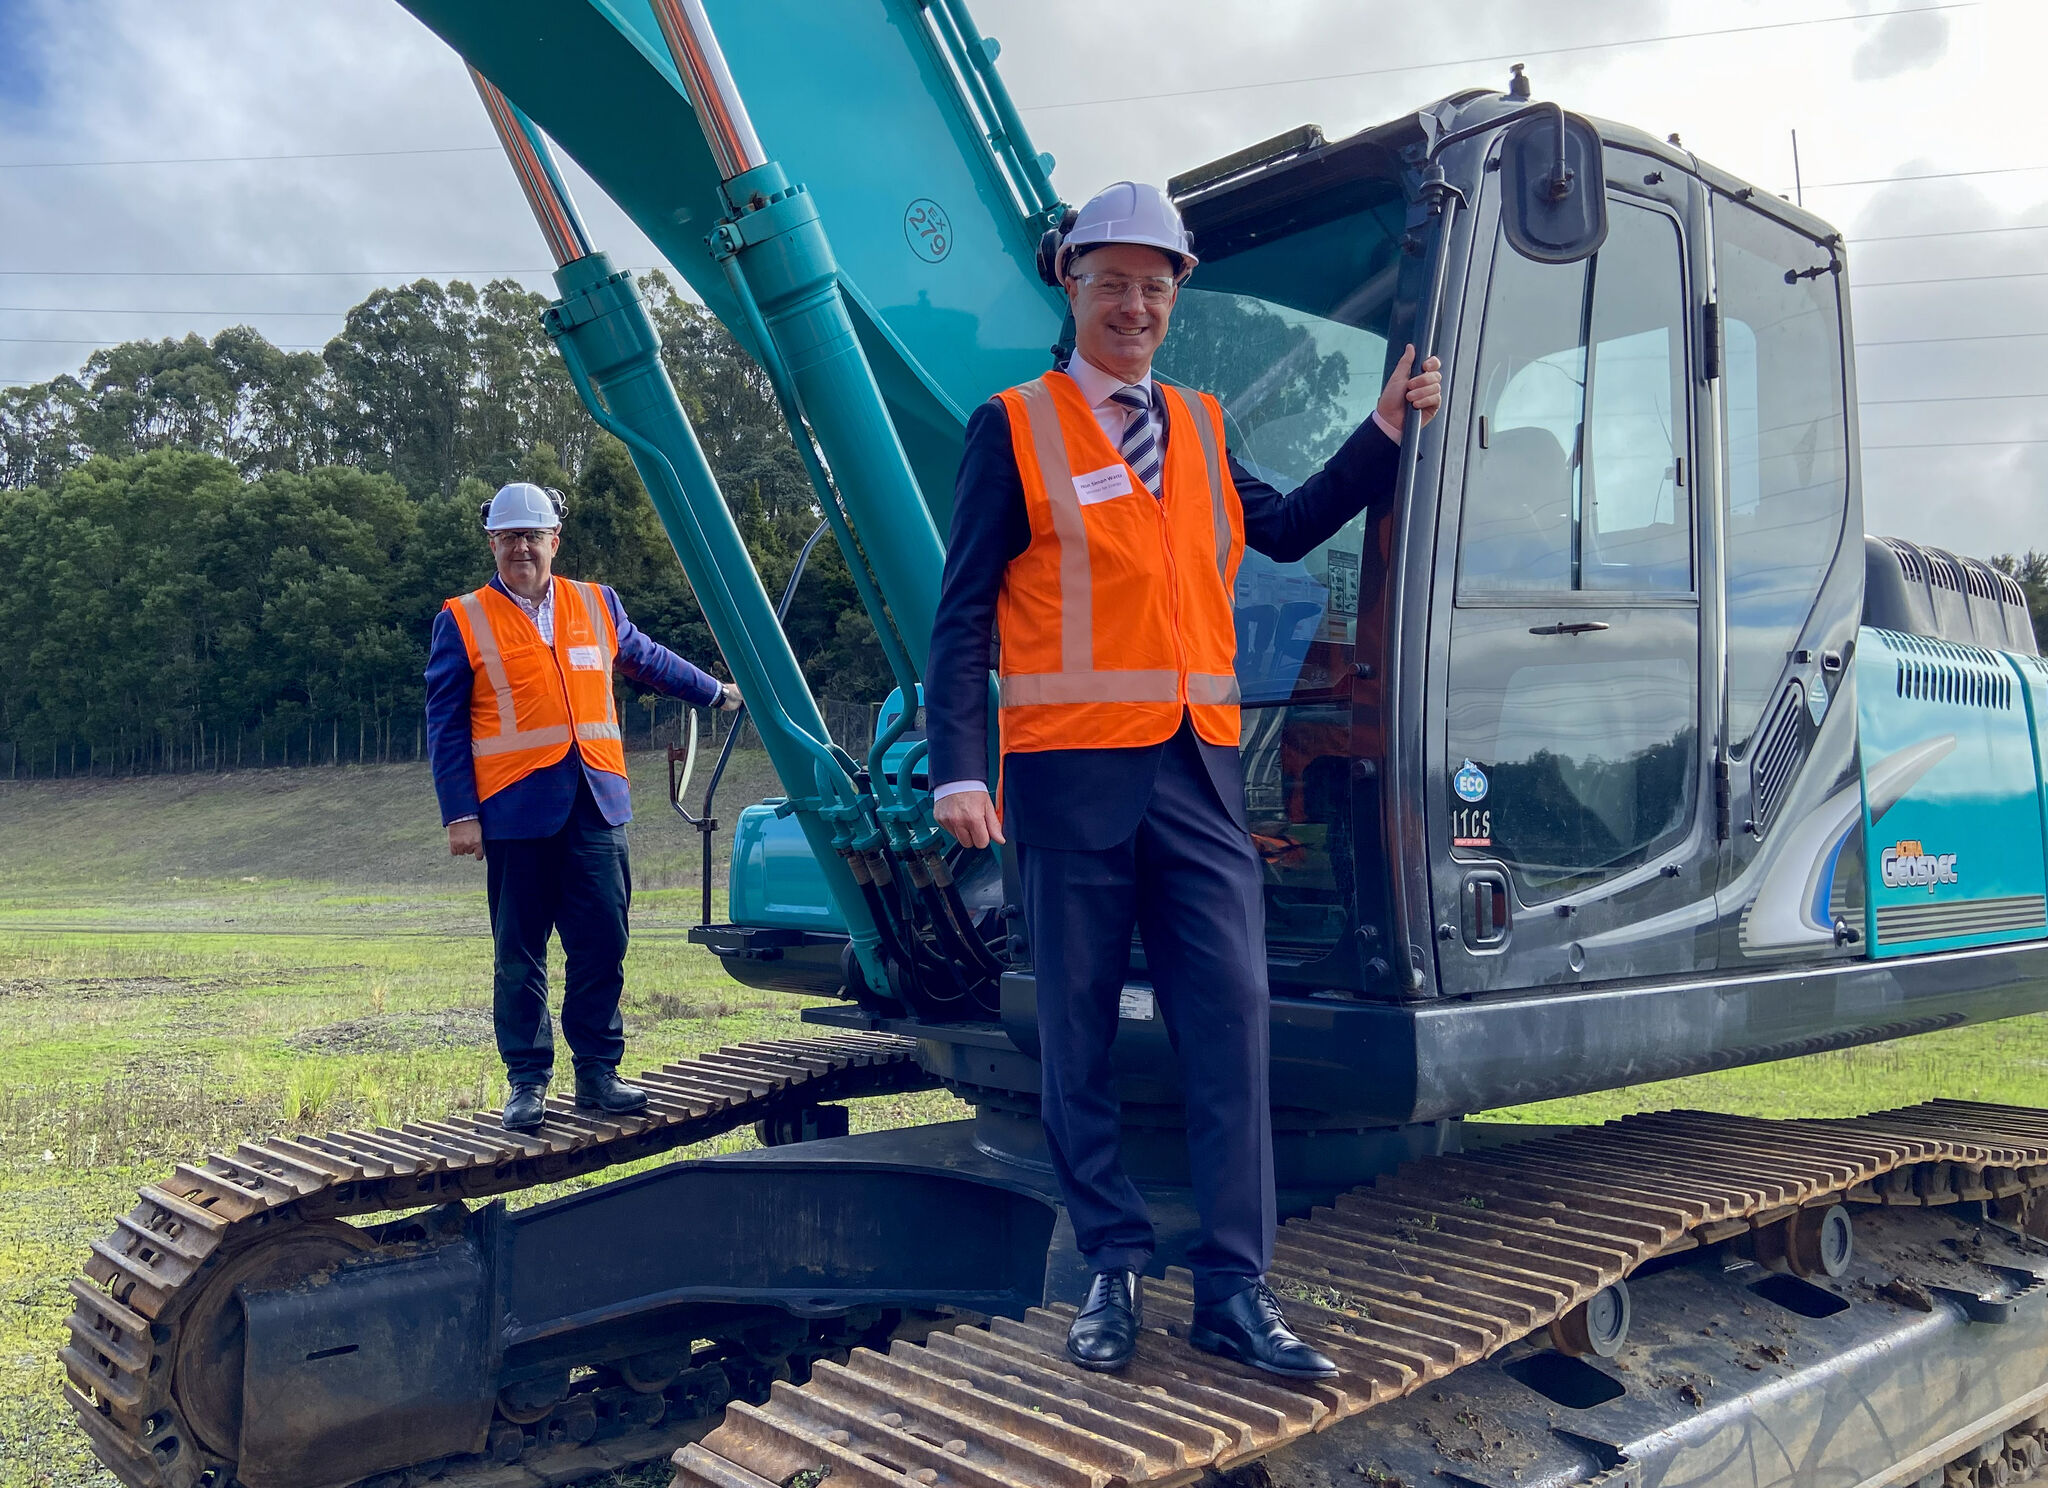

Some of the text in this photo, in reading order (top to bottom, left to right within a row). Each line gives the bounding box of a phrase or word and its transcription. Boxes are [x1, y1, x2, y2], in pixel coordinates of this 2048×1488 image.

[908, 207, 946, 255] 279
[927, 206, 947, 232] EX
[1460, 776, 1484, 793] ECO
[1453, 808, 1490, 838] ITCS
